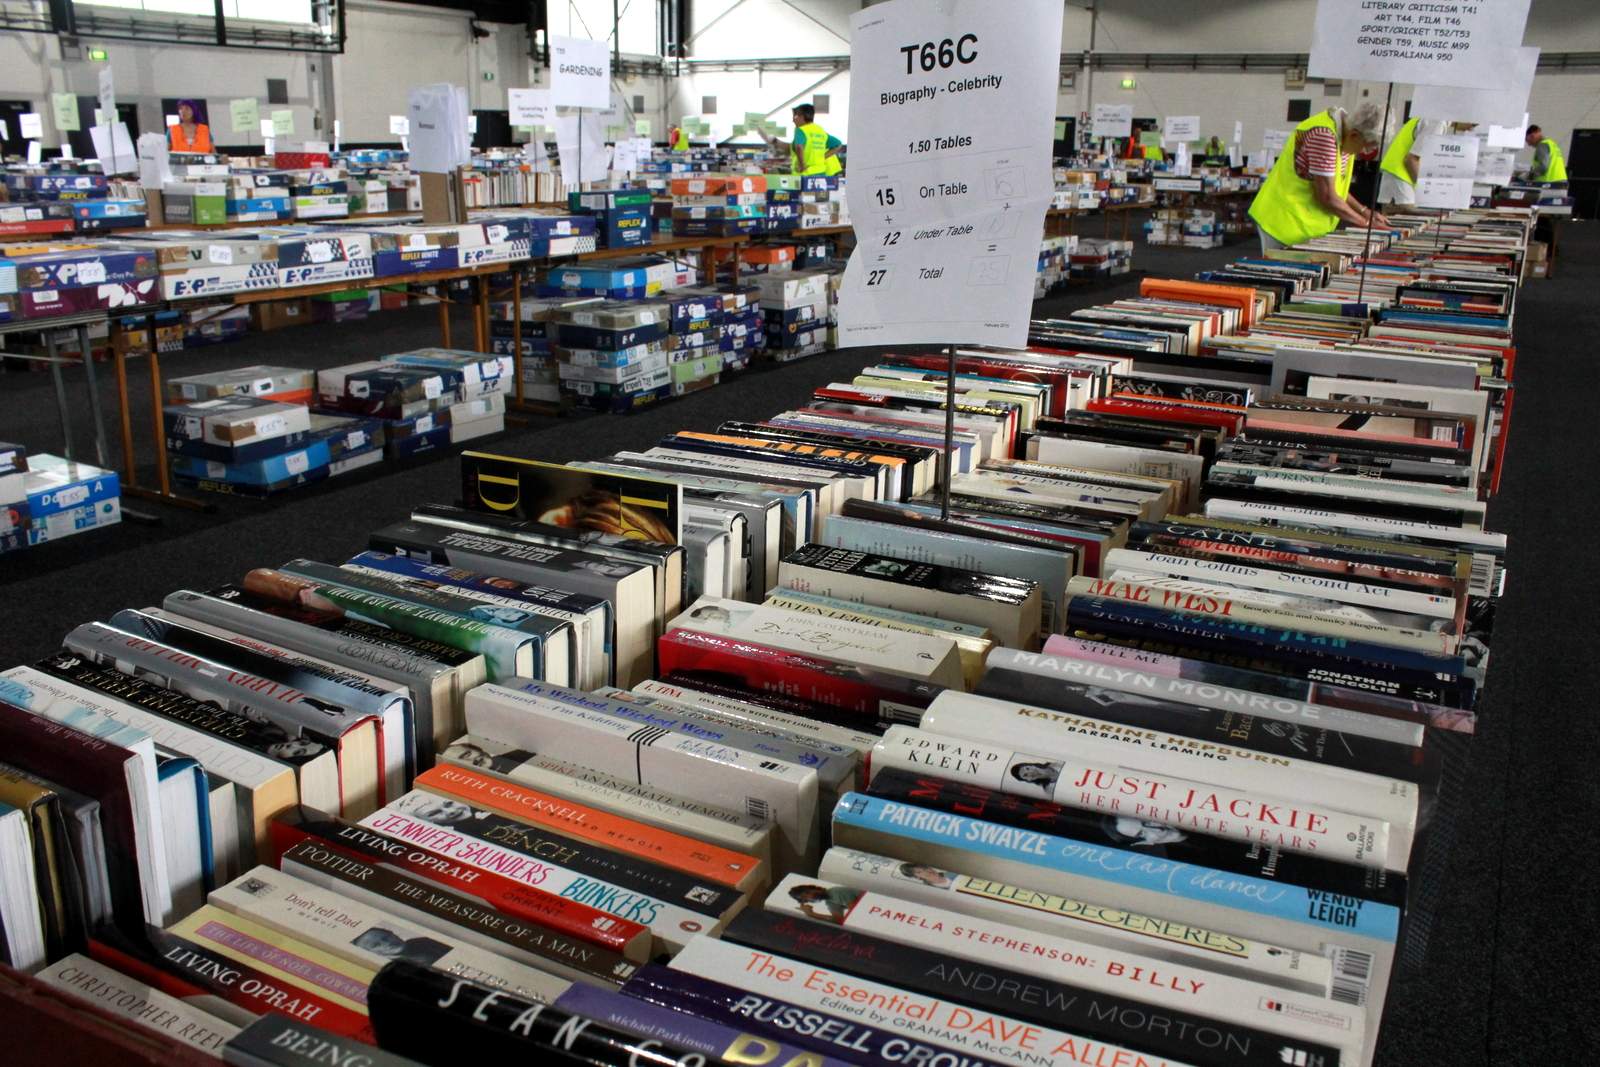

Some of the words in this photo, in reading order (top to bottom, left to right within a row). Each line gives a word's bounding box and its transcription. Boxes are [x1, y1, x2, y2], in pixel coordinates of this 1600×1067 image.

[1361, 1, 1405, 10] LITERARY
[1407, 3, 1458, 14] CRITICISM
[1462, 6, 1478, 14] T41
[1374, 14, 1392, 22] ART
[1396, 15, 1414, 24] T44,
[1418, 16, 1441, 24] FILM
[1445, 16, 1461, 26] T46
[1356, 36, 1392, 46] GENDER
[1395, 38, 1414, 48] T59,
[1418, 40, 1449, 49] MUSIC
[1450, 42, 1470, 50] M99
[1360, 24, 1430, 36] SPORT/CRICKET
[1434, 28, 1471, 38] T52/T53
[901, 33, 978, 75] T66C
[1370, 50, 1433, 60] AUSTRALIANA
[1436, 52, 1453, 61] 950
[559, 64, 603, 78] GARDENING
[880, 86, 937, 105] Biography
[948, 74, 1003, 94] Celebrity
[908, 139, 932, 154] 1.50
[934, 135, 972, 151] Tables
[875, 188, 896, 206] 15
[919, 186, 935, 199] On
[939, 182, 968, 197] Table
[882, 231, 901, 246] 12
[913, 228, 944, 240] Under
[945, 224, 974, 237] Table
[866, 269, 888, 286] 27
[919, 267, 944, 280] Total
[198, 480, 234, 495] REFLEX
[437, 537, 502, 557] RECALL
[1166, 525, 1276, 548] CAINE
[506, 543, 555, 563] TOTAL
[1146, 552, 1190, 568] Joan
[1194, 558, 1259, 578] Collins
[1278, 570, 1351, 592] Second
[1357, 582, 1392, 598] Act
[1308, 555, 1339, 565] IAN
[1348, 562, 1440, 581] HALPERIN
[327, 588, 364, 603] NIEMI
[363, 595, 391, 610] LISA
[389, 602, 418, 615] and
[515, 597, 574, 619] SHIRLEY
[1160, 590, 1233, 616] WEST
[416, 606, 467, 627] SWAYZE
[770, 597, 825, 617] VIVIEN
[826, 609, 882, 628] LEIGH
[126, 638, 207, 669] MILLER
[413, 635, 463, 658] BARRY
[1079, 644, 1126, 660] STILL
[1134, 655, 1161, 666] ME
[26, 679, 68, 699] Obscurity
[74, 672, 138, 699] KEELER
[226, 672, 306, 704] HARRY
[345, 675, 391, 698] MICKEY
[653, 684, 682, 699] TINA
[1013, 651, 1156, 687] MARILYN
[1167, 678, 1322, 719] MONROE
[1306, 673, 1398, 695] MARGOLIS
[1307, 667, 1401, 689] JONATHAN
[77, 699, 102, 713] Blaze
[140, 694, 248, 739] CHRISTINE
[197, 704, 225, 720] Truth
[487, 688, 537, 706] Seriously
[573, 709, 630, 731] Kidding
[615, 706, 679, 729] Wicked
[680, 722, 725, 740] Ways
[1017, 706, 1160, 741] KATHARINE
[1167, 736, 1291, 767] HEPBURN
[902, 737, 999, 762] EDWARD
[1067, 726, 1142, 745] BARBARA
[1150, 741, 1229, 761] LEAMING
[908, 750, 981, 775] KLEIN
[440, 769, 487, 790] RUTH
[489, 779, 588, 822] CRACKNELL
[537, 760, 576, 776] SPIKE
[579, 774, 598, 784] AN
[600, 778, 673, 804] INTIMATE
[680, 800, 740, 823] MEMOIR
[1074, 767, 1168, 800] JUST
[1179, 789, 1329, 835] JACKIE
[879, 803, 963, 837] PATRICK
[965, 820, 1055, 856] SWAYZE
[1080, 791, 1122, 811] HER
[1134, 804, 1229, 833] PRIVATE
[1245, 824, 1317, 850] YEARS
[339, 826, 410, 857] LIVING
[407, 850, 482, 884] OPRAH
[483, 823, 581, 863] DENCH
[608, 830, 663, 851] MEMOIR
[371, 813, 464, 853] JENNIFER
[457, 841, 558, 886] SAUNDERS
[559, 876, 666, 926] BONKERS
[585, 857, 618, 870] JOHN
[626, 870, 672, 887] MILLER
[1062, 843, 1121, 870] one
[1190, 869, 1288, 903] dance
[284, 893, 315, 910] Don't
[313, 904, 337, 920] tell
[335, 913, 363, 929] Dad
[298, 842, 376, 881] POITIER
[391, 880, 424, 902] THE
[425, 891, 502, 931] MEASURE
[503, 919, 531, 938] OF
[528, 932, 545, 945] A
[545, 938, 597, 964] MAN
[1306, 888, 1365, 910] WENDY
[965, 877, 1055, 907] ELLEN
[1058, 897, 1246, 952] DEGENERES
[1308, 900, 1358, 928] LEIGH
[205, 923, 228, 939] THE
[229, 932, 259, 953] LIFE
[262, 949, 279, 961] OF
[279, 955, 313, 973] NOEL
[317, 968, 369, 998] COWARD
[868, 905, 945, 932] PAMELA
[951, 926, 1097, 968] STEPHENSON:
[1106, 961, 1206, 995] BILLY
[163, 946, 242, 986] LIVING
[239, 979, 322, 1021] OPRAH
[57, 966, 181, 1031] CHRISTOPHER
[745, 951, 795, 982] The
[803, 968, 939, 1021] Essential
[946, 1006, 1045, 1050] DAVE
[924, 963, 1079, 1012] ANDREW
[1087, 1000, 1251, 1056] MORTON
[437, 979, 592, 1051] SEAN
[730, 994, 873, 1053] RUSSELL
[608, 1012, 654, 1034] Michael
[655, 1023, 716, 1053] Parkinson
[819, 996, 866, 1016] Edited
[868, 1008, 889, 1023] by
[892, 1016, 967, 1045] GRAHAM
[973, 1038, 1055, 1067] McCANN
[270, 1027, 373, 1067] BEING
